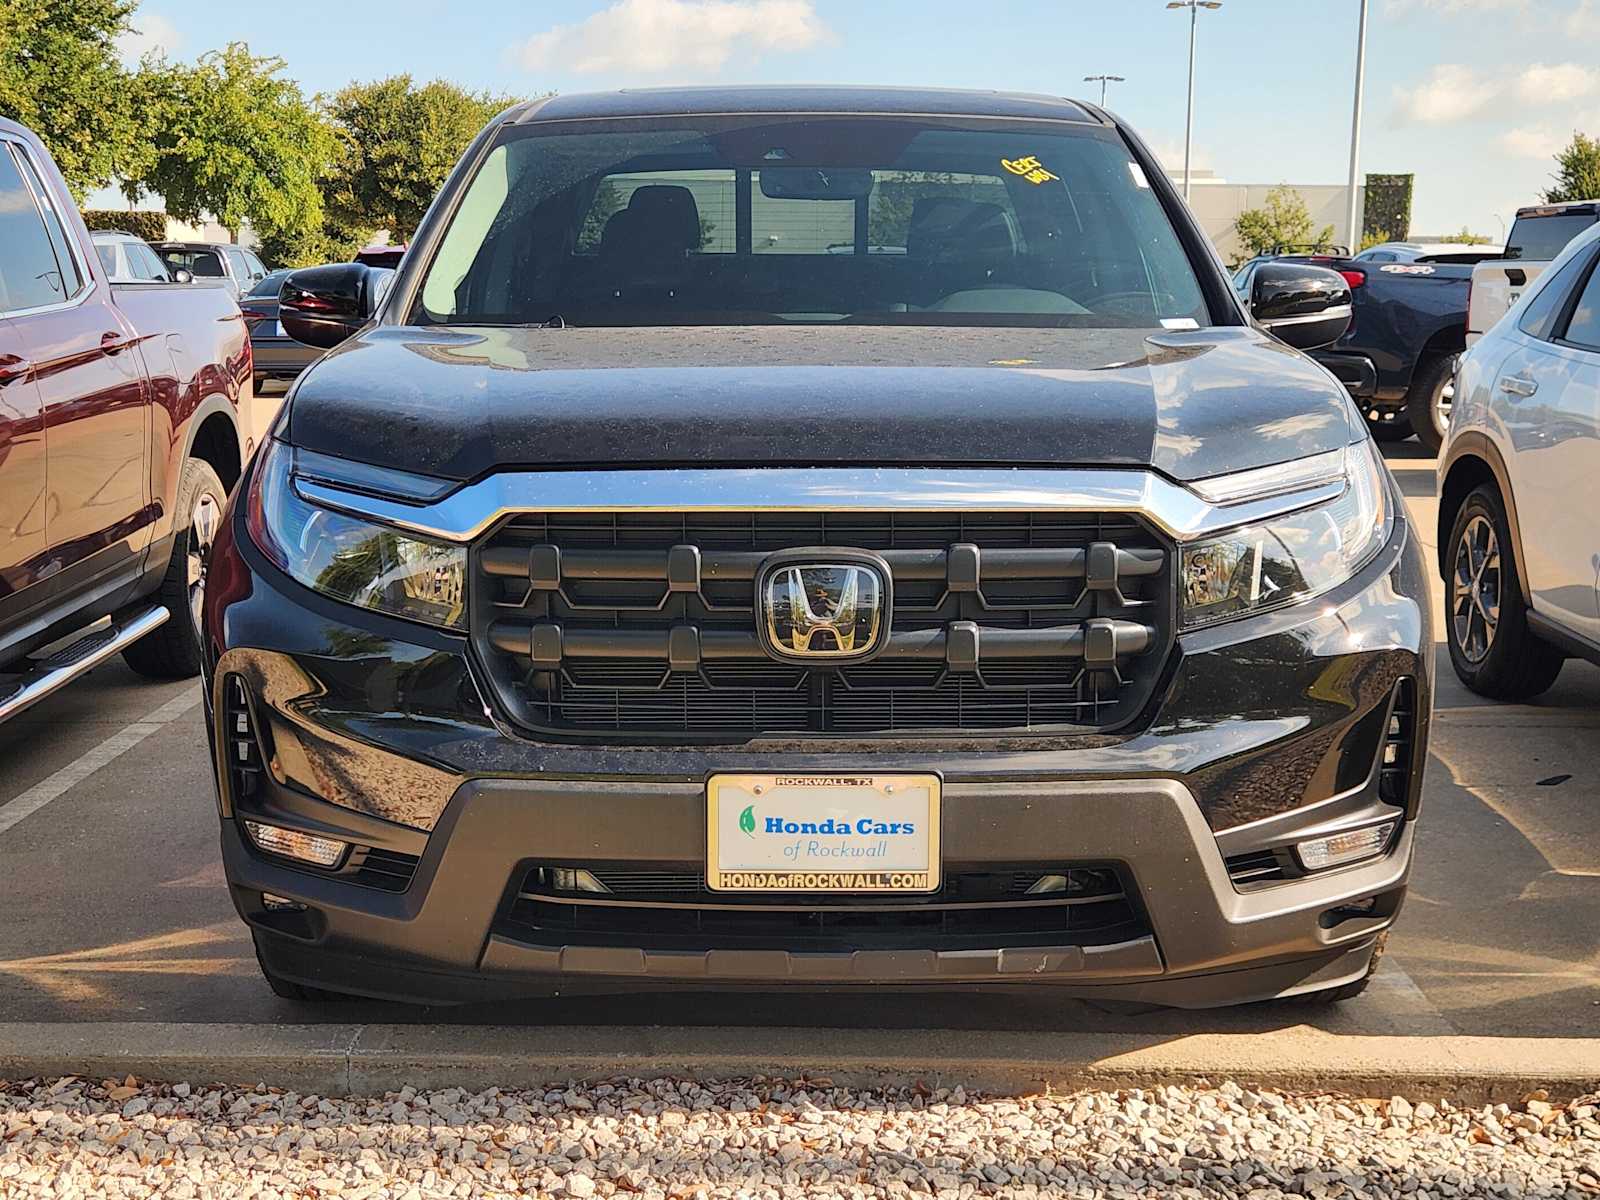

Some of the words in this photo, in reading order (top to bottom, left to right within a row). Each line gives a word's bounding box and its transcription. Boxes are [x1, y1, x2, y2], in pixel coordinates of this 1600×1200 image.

[855, 778, 872, 786] TX
[765, 817, 851, 835] Honda
[856, 818, 915, 836] Cars
[783, 841, 801, 861] of
[807, 840, 888, 858] Rockwall
